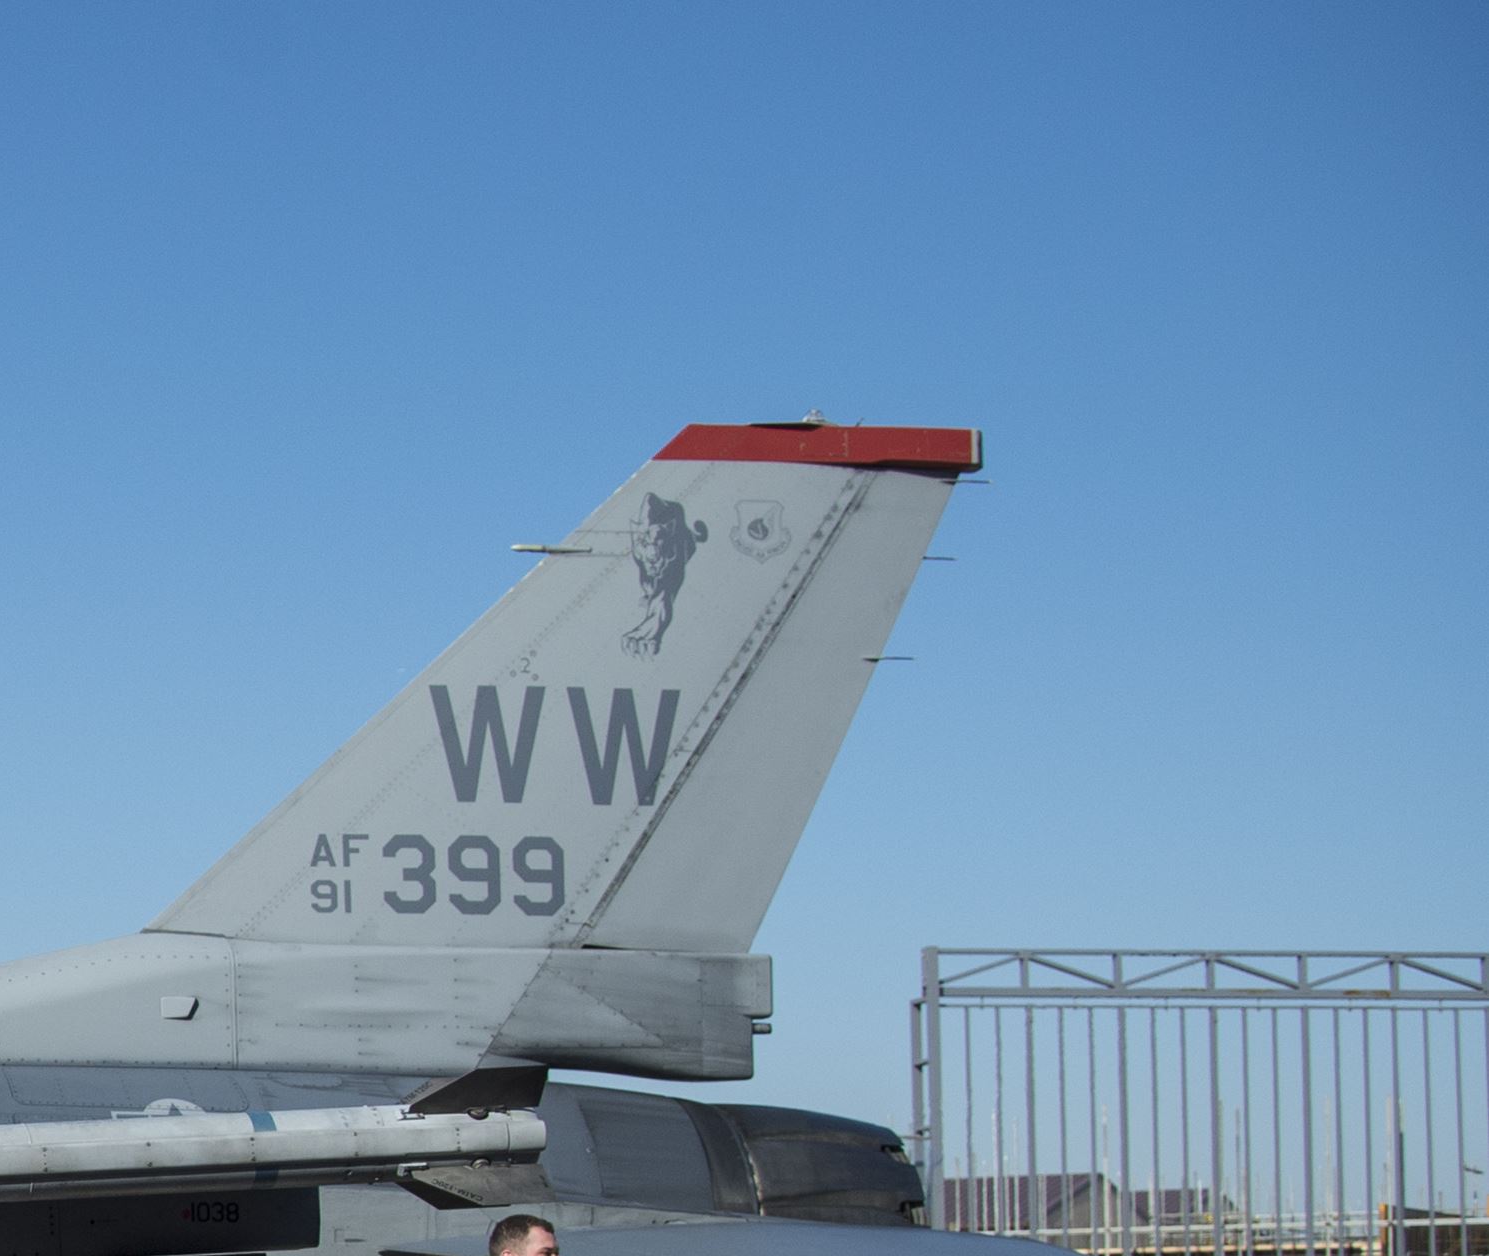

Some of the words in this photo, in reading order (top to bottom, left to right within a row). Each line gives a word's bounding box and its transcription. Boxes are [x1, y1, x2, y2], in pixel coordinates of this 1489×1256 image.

[310, 833, 370, 868] AF
[381, 833, 566, 917] 399
[310, 879, 353, 914] 91
[190, 1201, 240, 1223] 1038
